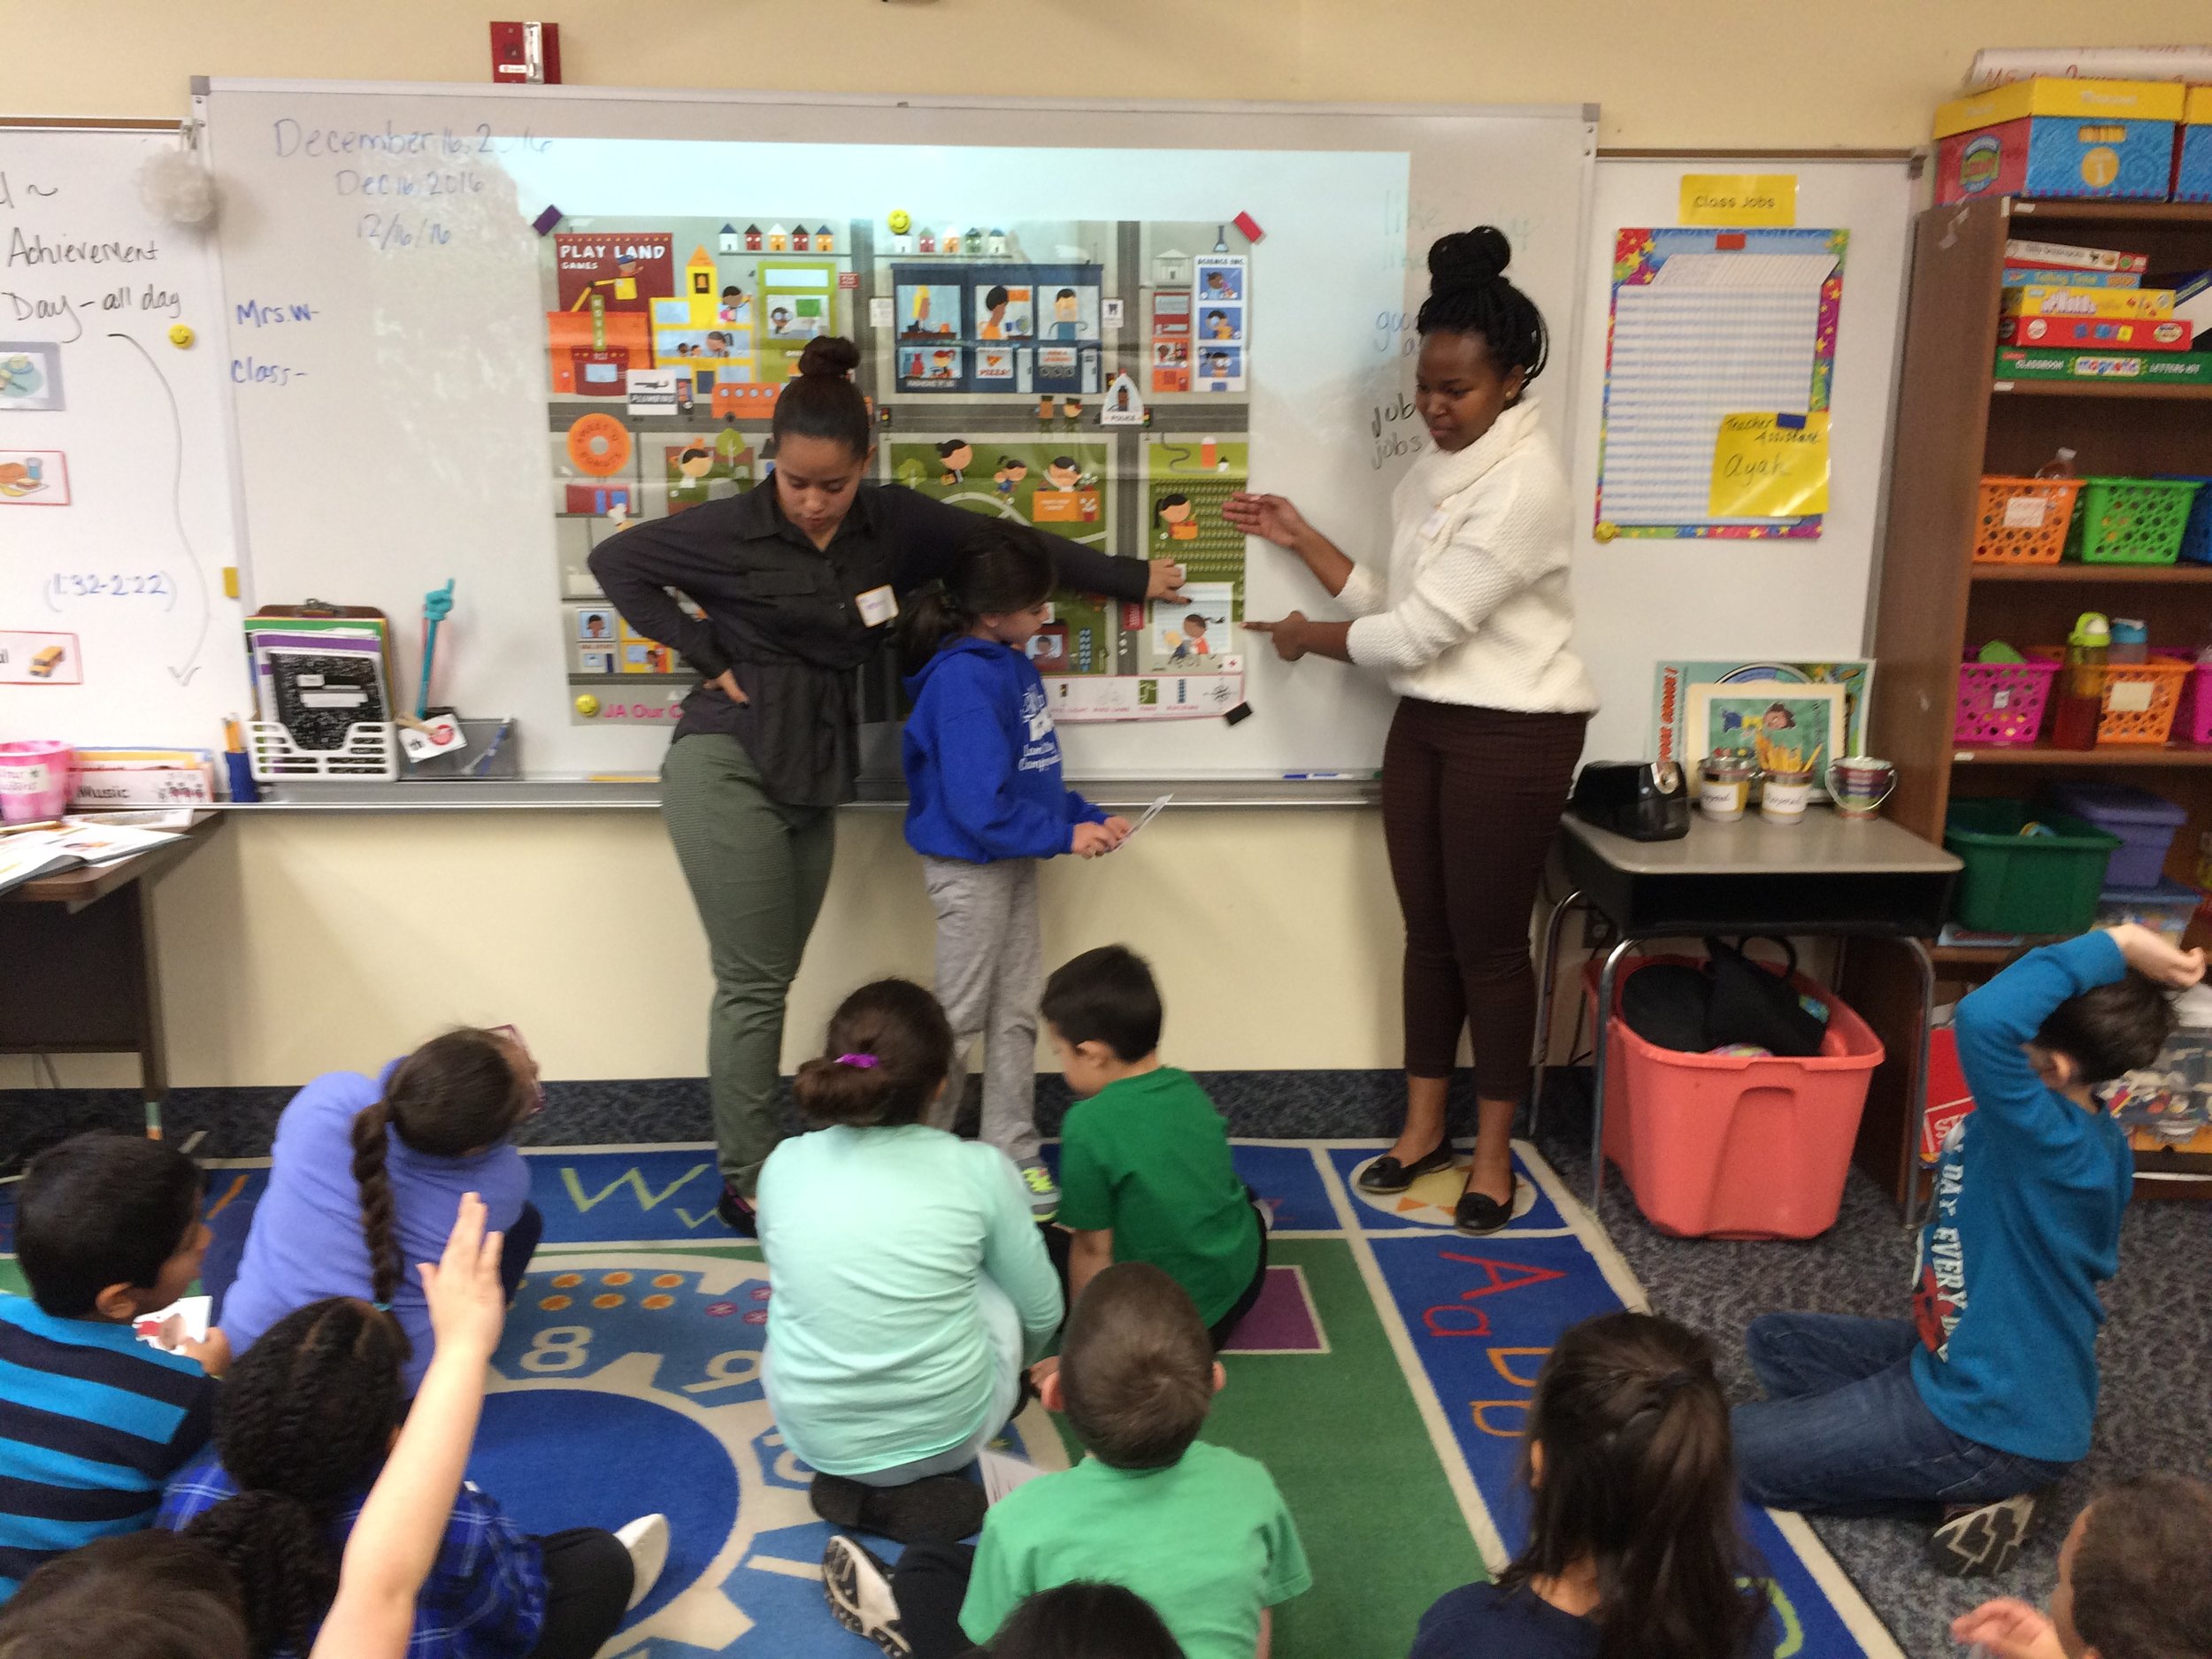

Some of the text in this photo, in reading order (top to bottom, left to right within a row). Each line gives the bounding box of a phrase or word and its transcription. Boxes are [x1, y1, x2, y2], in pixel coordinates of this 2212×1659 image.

[273, 119, 434, 157] December
[8, 227, 159, 266] Achievement
[559, 245, 665, 259] PLAY LAND
[519, 1325, 594, 1372] 8
